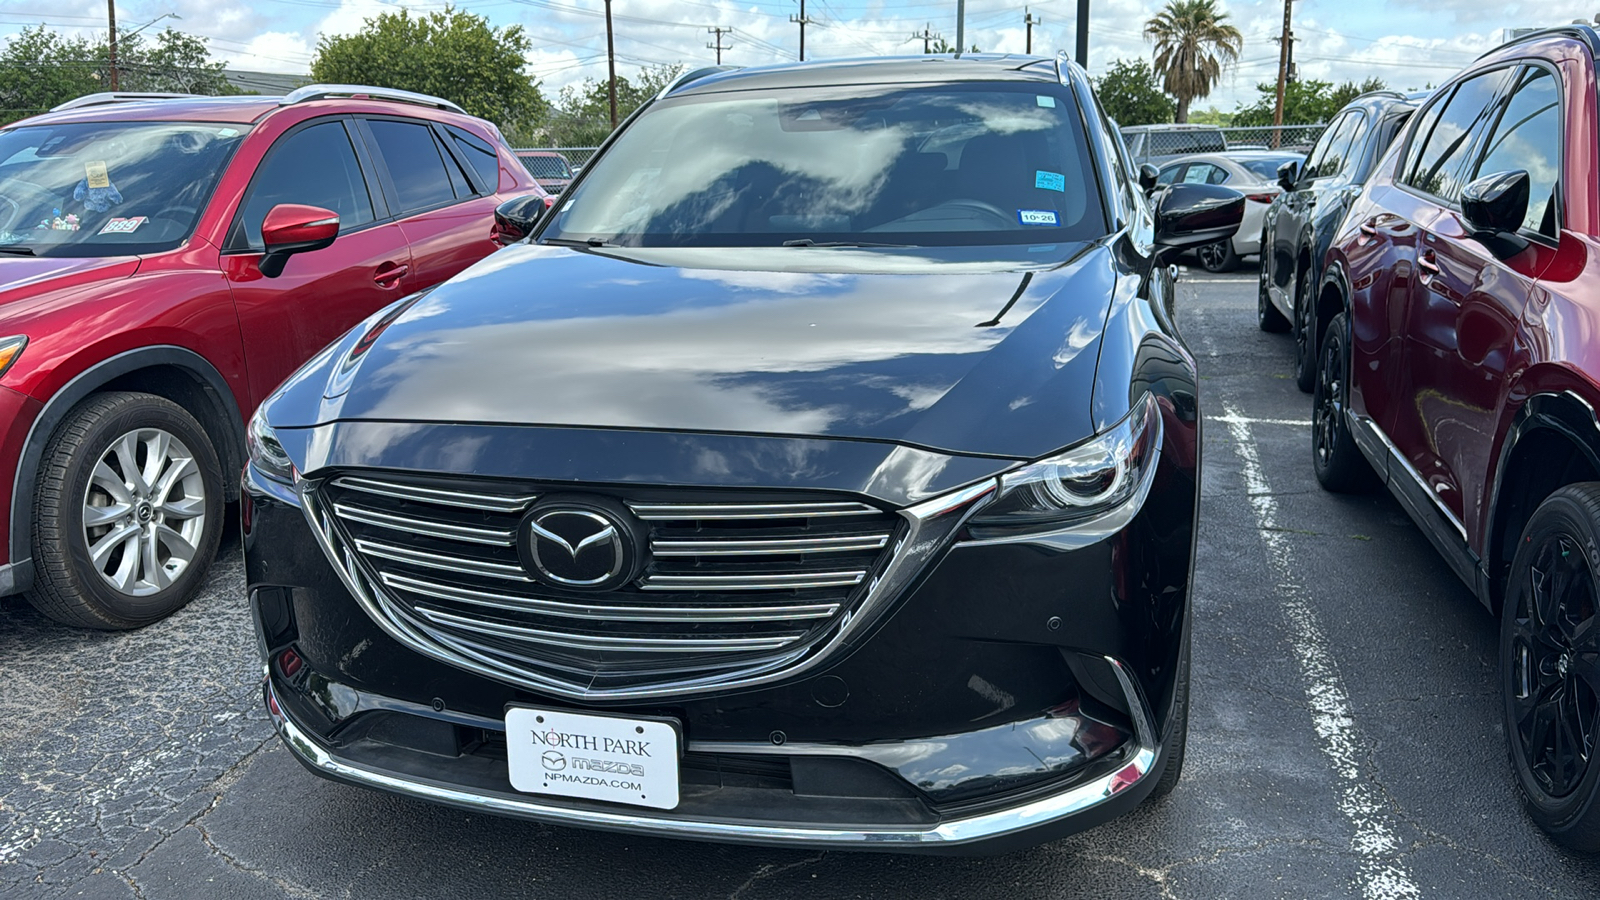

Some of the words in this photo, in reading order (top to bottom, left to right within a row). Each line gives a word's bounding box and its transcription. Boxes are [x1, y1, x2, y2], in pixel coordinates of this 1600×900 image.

[530, 730, 598, 751] NORTH
[603, 737, 652, 757] PARK
[571, 757, 645, 777] mazda
[544, 772, 642, 791] NPMAZDA.COM
